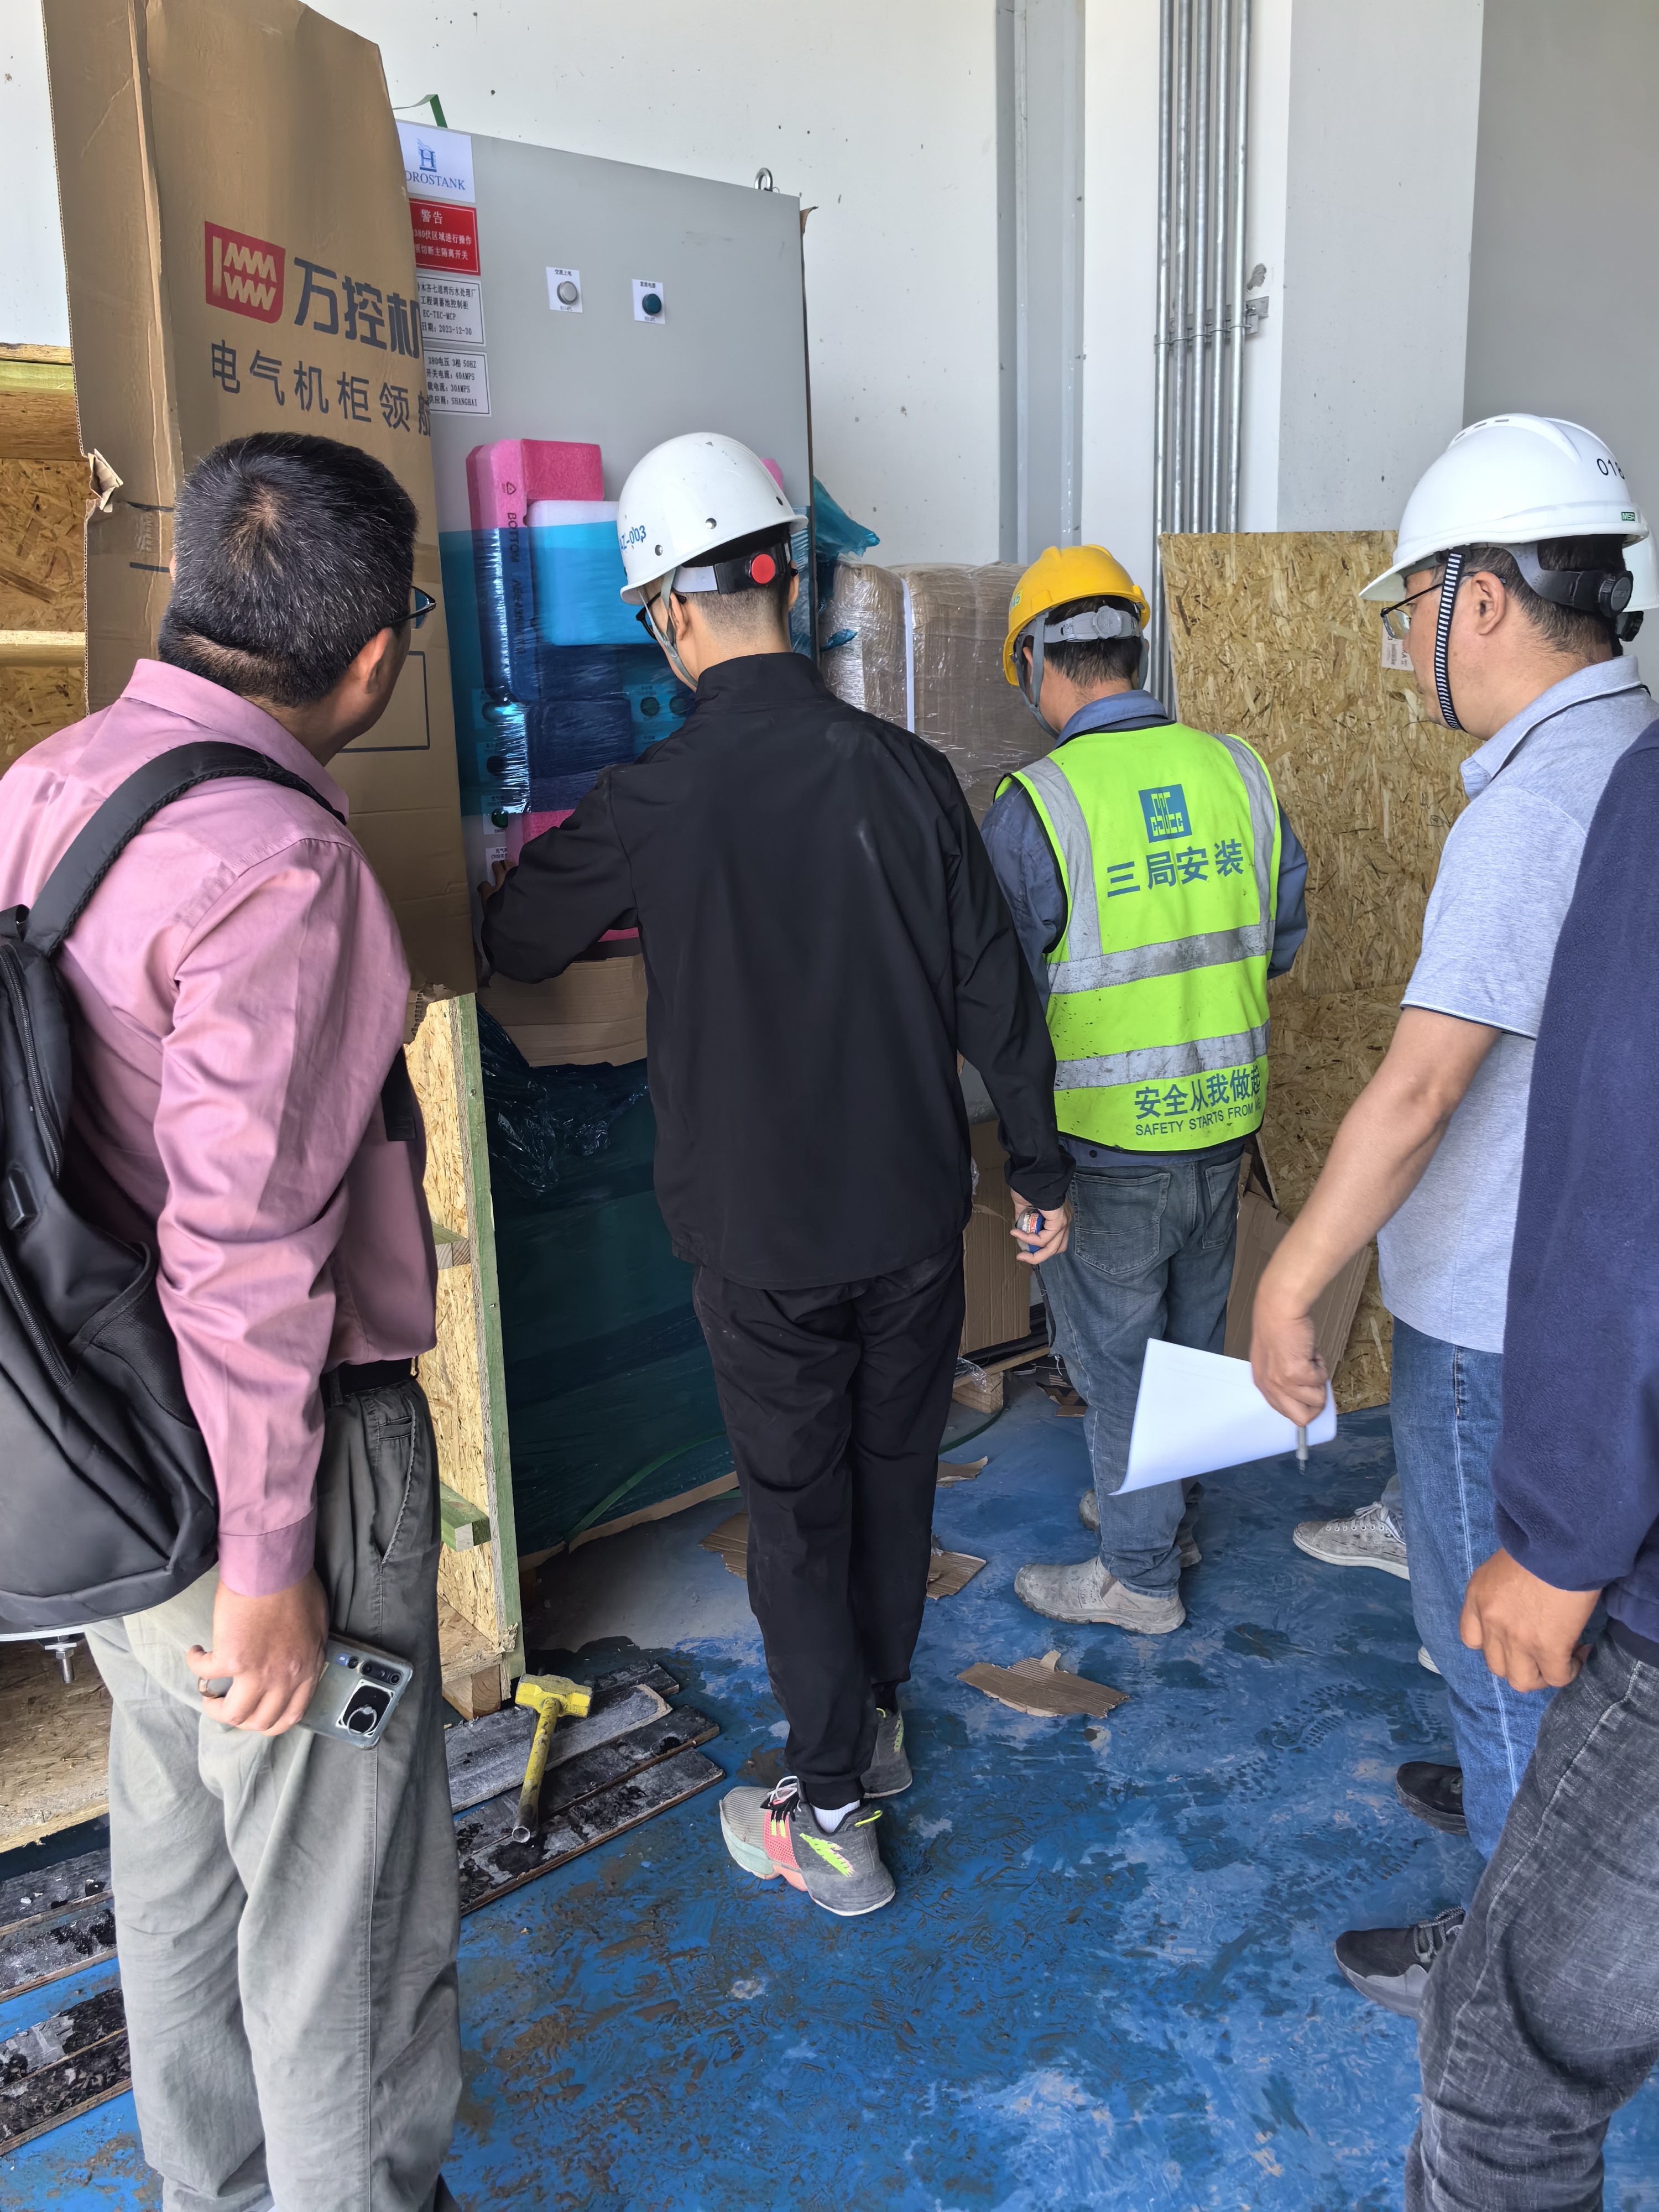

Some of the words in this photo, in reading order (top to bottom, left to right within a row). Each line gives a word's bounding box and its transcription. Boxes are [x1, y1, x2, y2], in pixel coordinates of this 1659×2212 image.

[421, 209, 443, 225] 警告
[418, 281, 476, 298] 木齐七道湾污水处理厂
[1107, 838, 1244, 898] 三局安装
[1135, 1065, 1261, 1120] 安全从我做起
[1135, 1120, 1184, 1136] SAFETY
[1189, 1110, 1224, 1130] STARTS
[1228, 1102, 1254, 1120] FROM
